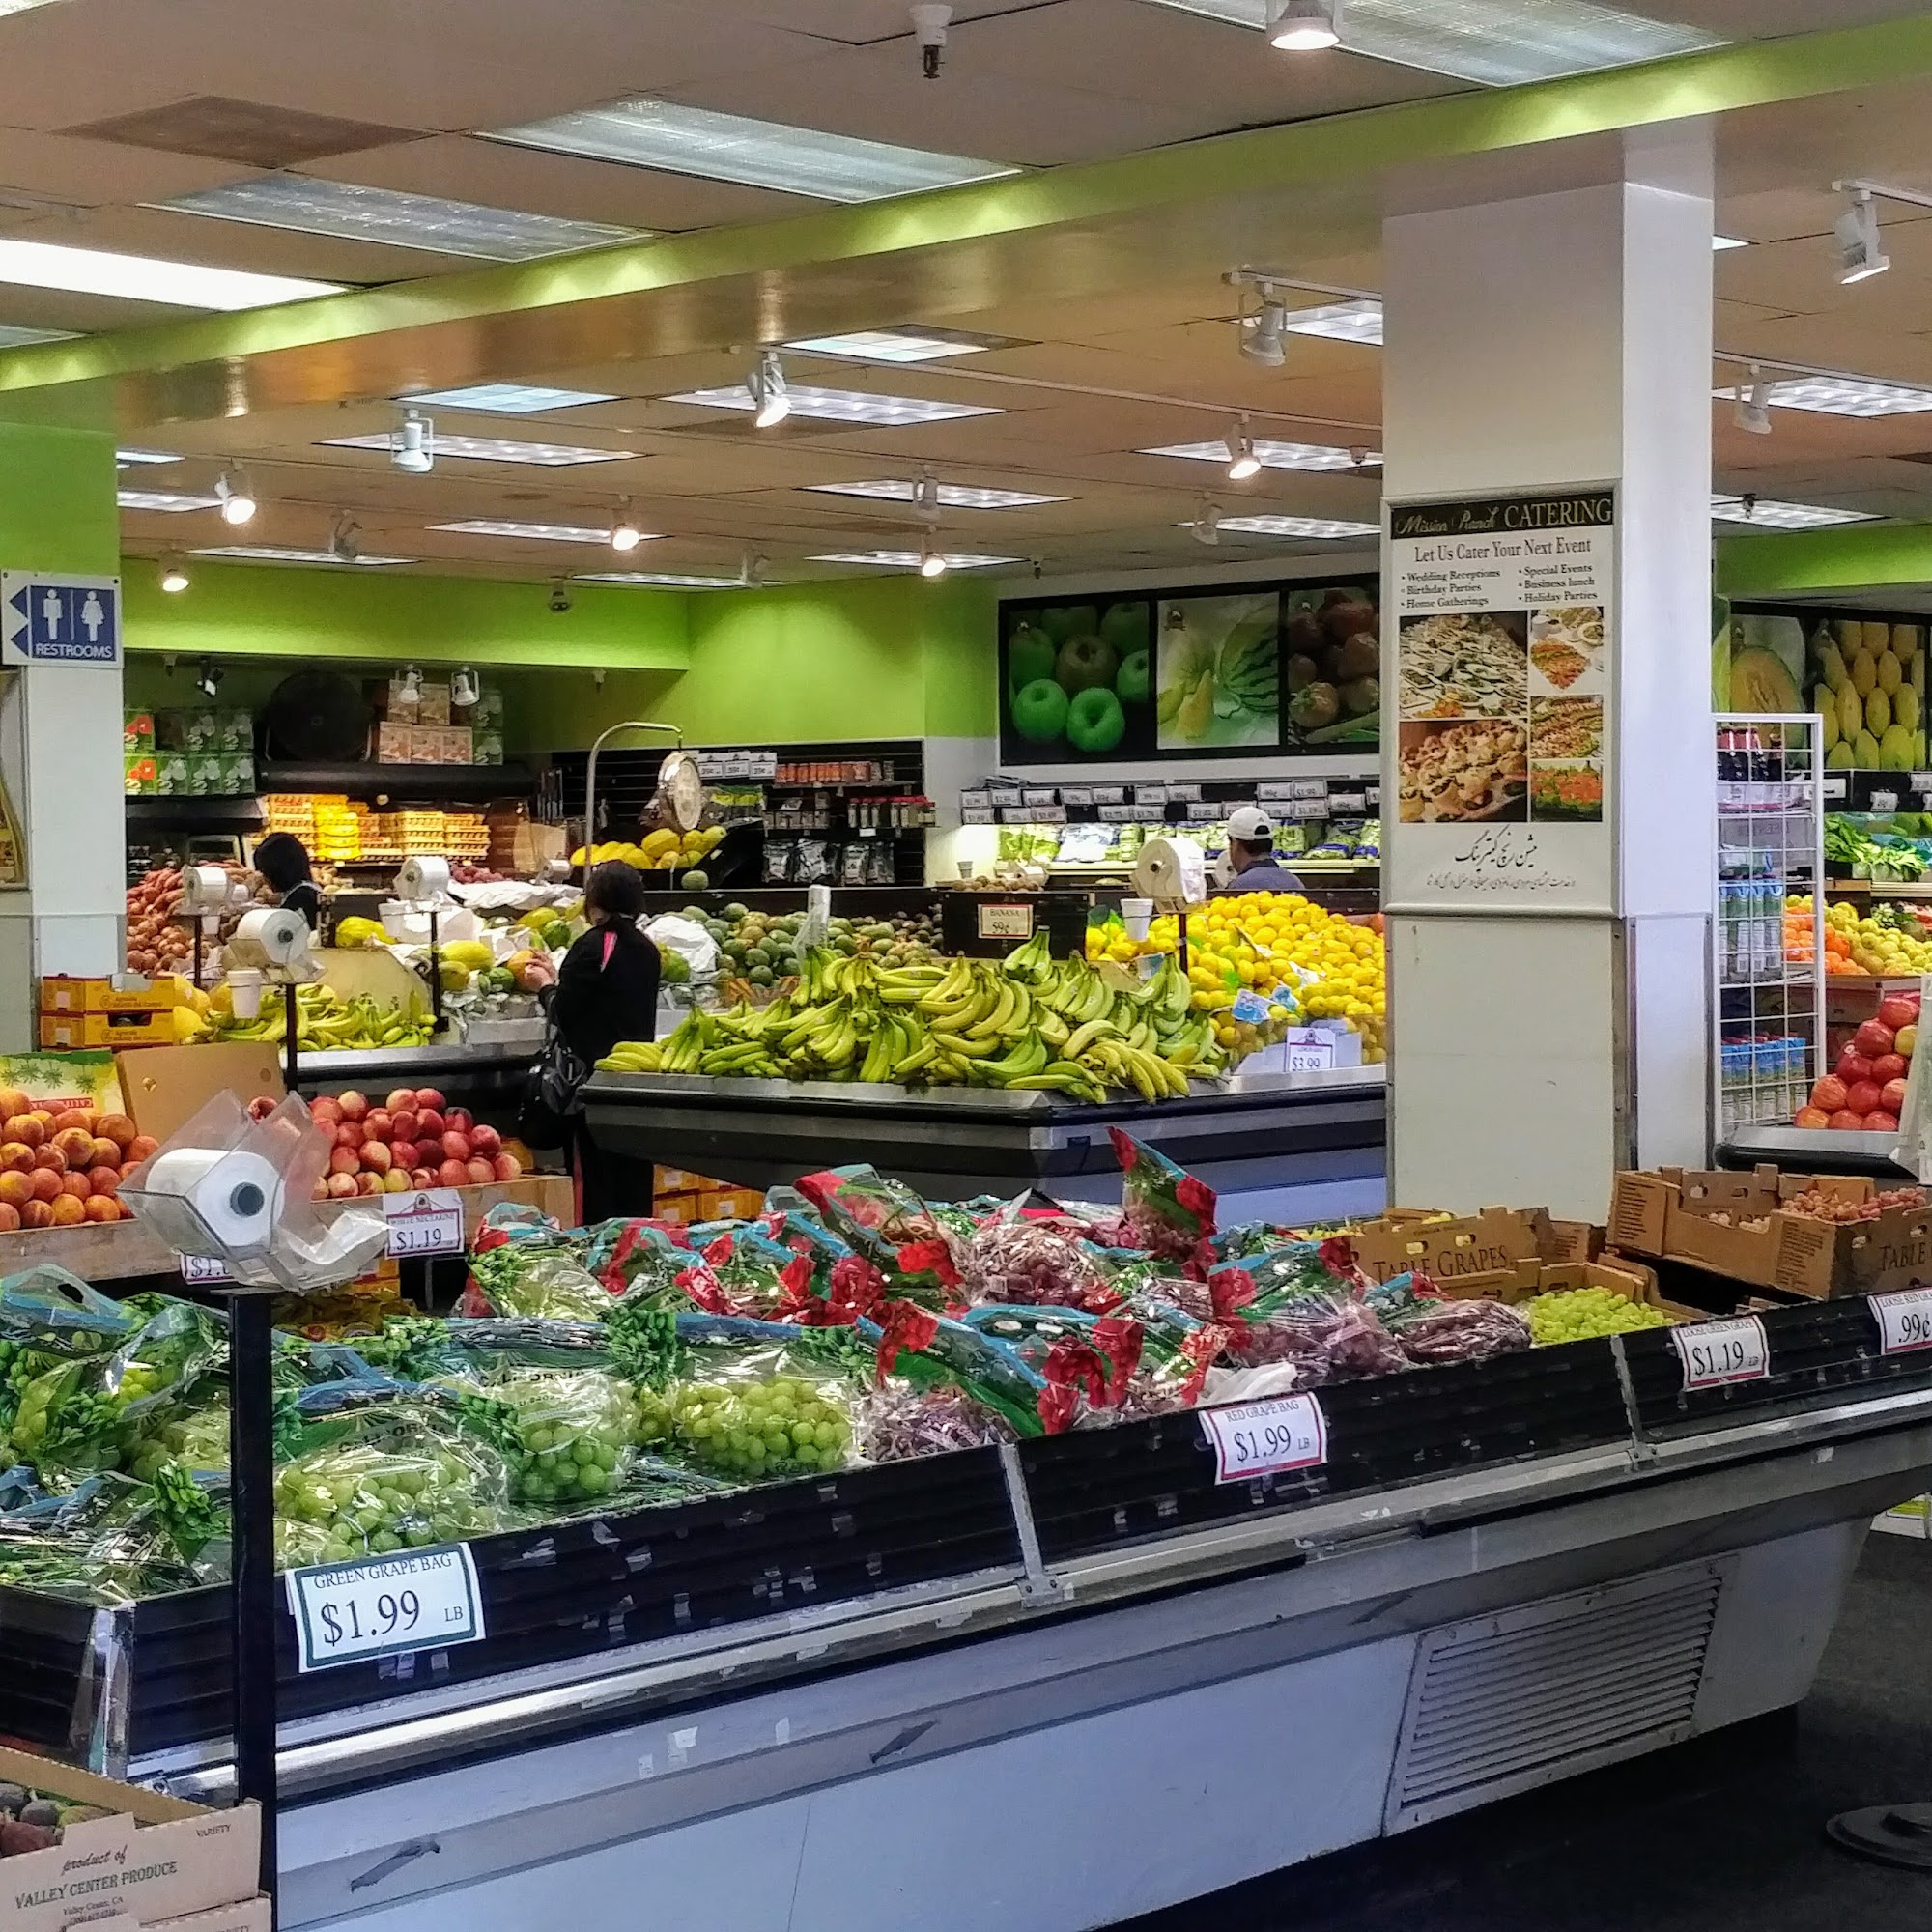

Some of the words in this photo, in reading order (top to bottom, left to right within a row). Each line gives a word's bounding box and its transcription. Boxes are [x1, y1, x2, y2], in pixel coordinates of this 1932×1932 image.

[1504, 498, 1613, 528] CATERING
[1414, 546, 1435, 563] Let
[1437, 544, 1454, 561] Us
[1456, 543, 1490, 559] Cater
[1492, 541, 1522, 557] Your
[1524, 539, 1553, 555] Next
[1555, 536, 1592, 553] Event
[1406, 571, 1448, 582] Wedding
[1449, 569, 1501, 581] Receptions
[1524, 565, 1558, 578] Special
[1560, 564, 1593, 574] Events
[1524, 579, 1566, 589] Business
[1568, 576, 1595, 586] lunch
[1406, 584, 1447, 596] Birthday
[1449, 582, 1482, 593] Parties
[1524, 592, 1560, 604] Holiday
[1564, 590, 1598, 601] Parties
[1406, 599, 1435, 609] Home
[1437, 596, 1489, 608] Gatherings
[35, 642, 114, 658] RESTROOMS
[396, 1228, 442, 1251] $1.19
[1437, 1244, 1508, 1277] GRAPES
[1879, 1242, 1925, 1271] TABLE
[1880, 1296, 1904, 1307] LOOSE
[1904, 1293, 1918, 1304] RED
[1681, 1326, 1706, 1337] LOOSE
[1730, 1321, 1753, 1330] GRAPE
[1898, 1313, 1930, 1343] .99¢
[1692, 1340, 1744, 1376] $1.19
[1224, 1410, 1246, 1422] RED
[1246, 1404, 1276, 1418] GRAPE
[1278, 1400, 1299, 1410] BAG
[1234, 1424, 1292, 1463] $1.99
[1298, 1437, 1310, 1449] LB
[314, 1568, 366, 1588] GREEN
[368, 1559, 418, 1578] GRAPE
[420, 1553, 452, 1570] BAG
[320, 1589, 420, 1647] $1.99
[444, 1605, 464, 1622] LB
[196, 1823, 231, 1837] VARIETY
[61, 1850, 111, 1876] product
[114, 1844, 128, 1864] of
[14, 1884, 68, 1909] VALLEY
[69, 1873, 118, 1896] CENTER
[121, 1861, 178, 1886] PRODUCE
